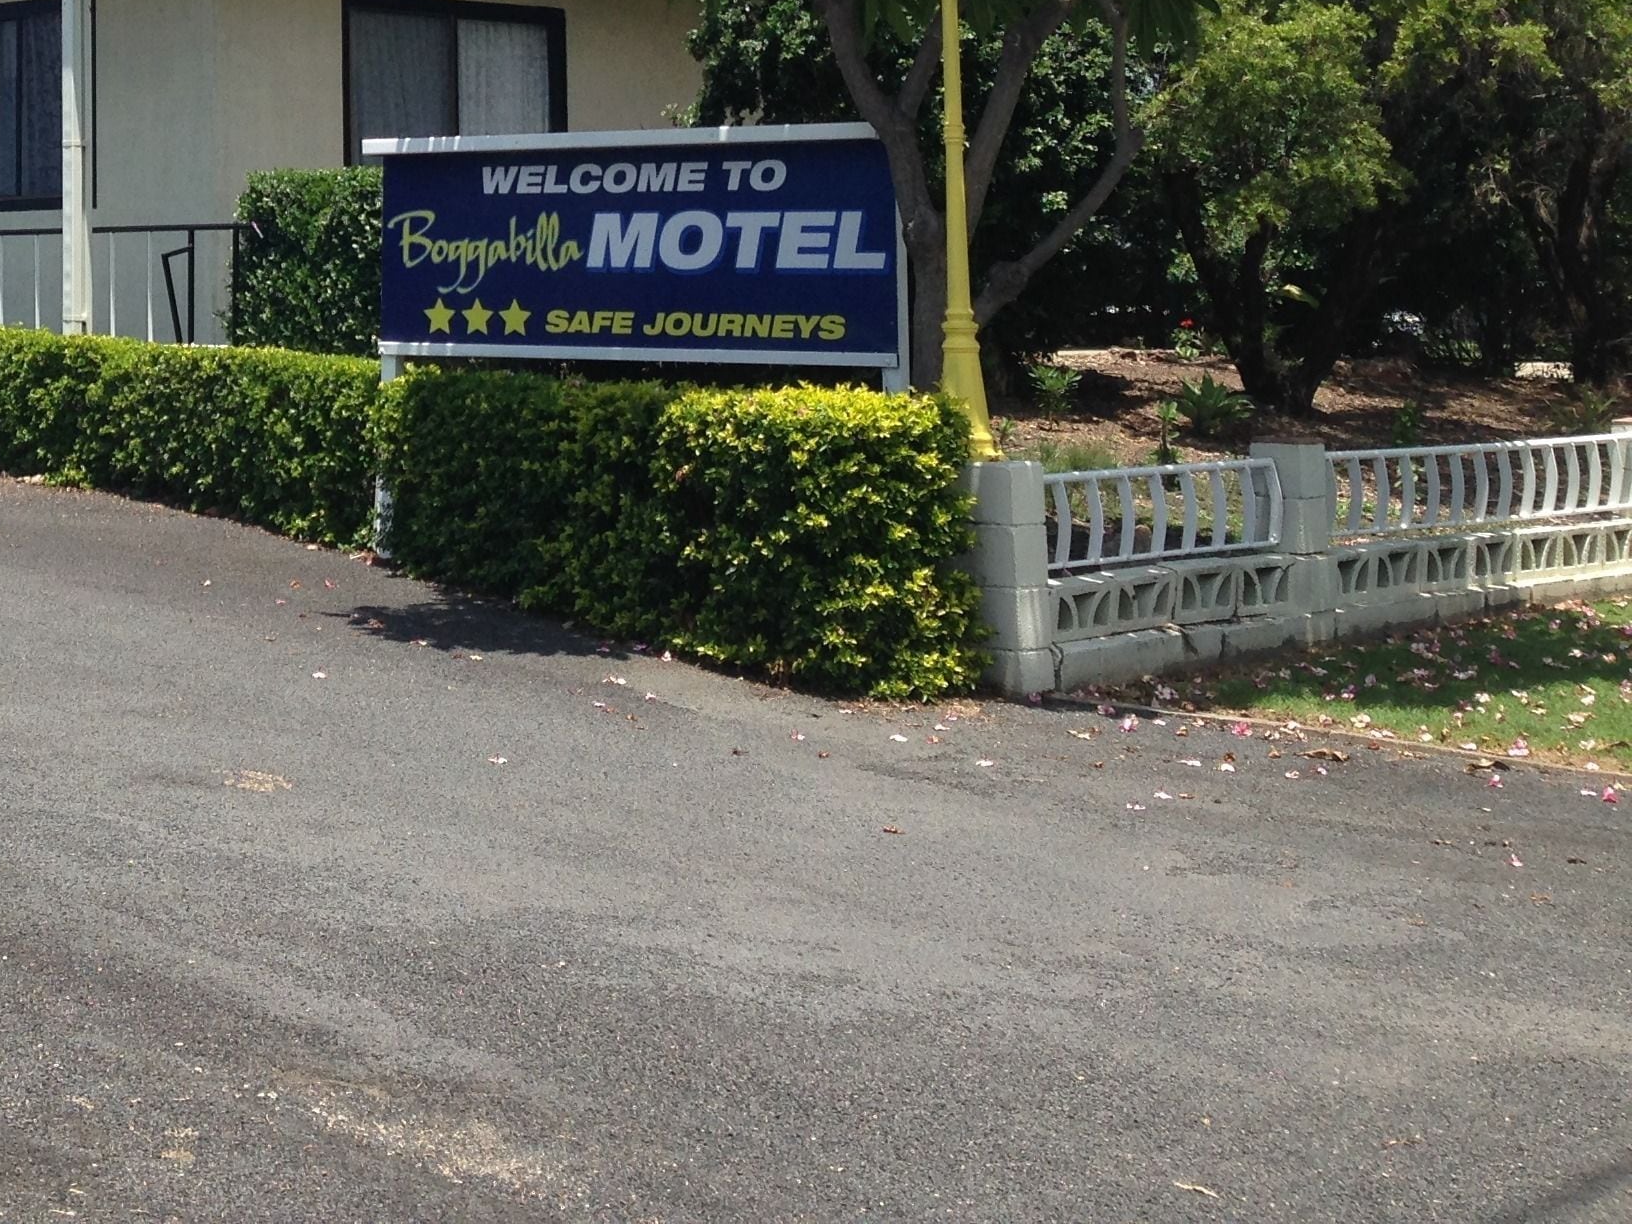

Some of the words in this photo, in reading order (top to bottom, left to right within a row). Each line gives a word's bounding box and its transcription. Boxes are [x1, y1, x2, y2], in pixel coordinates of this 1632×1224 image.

[482, 162, 707, 194] WELCOME
[722, 160, 787, 191] TO
[388, 210, 583, 293] Boggabilla
[585, 210, 887, 269] MOTEL
[545, 309, 633, 335] SAFE
[643, 312, 847, 340] JOURNEYS
